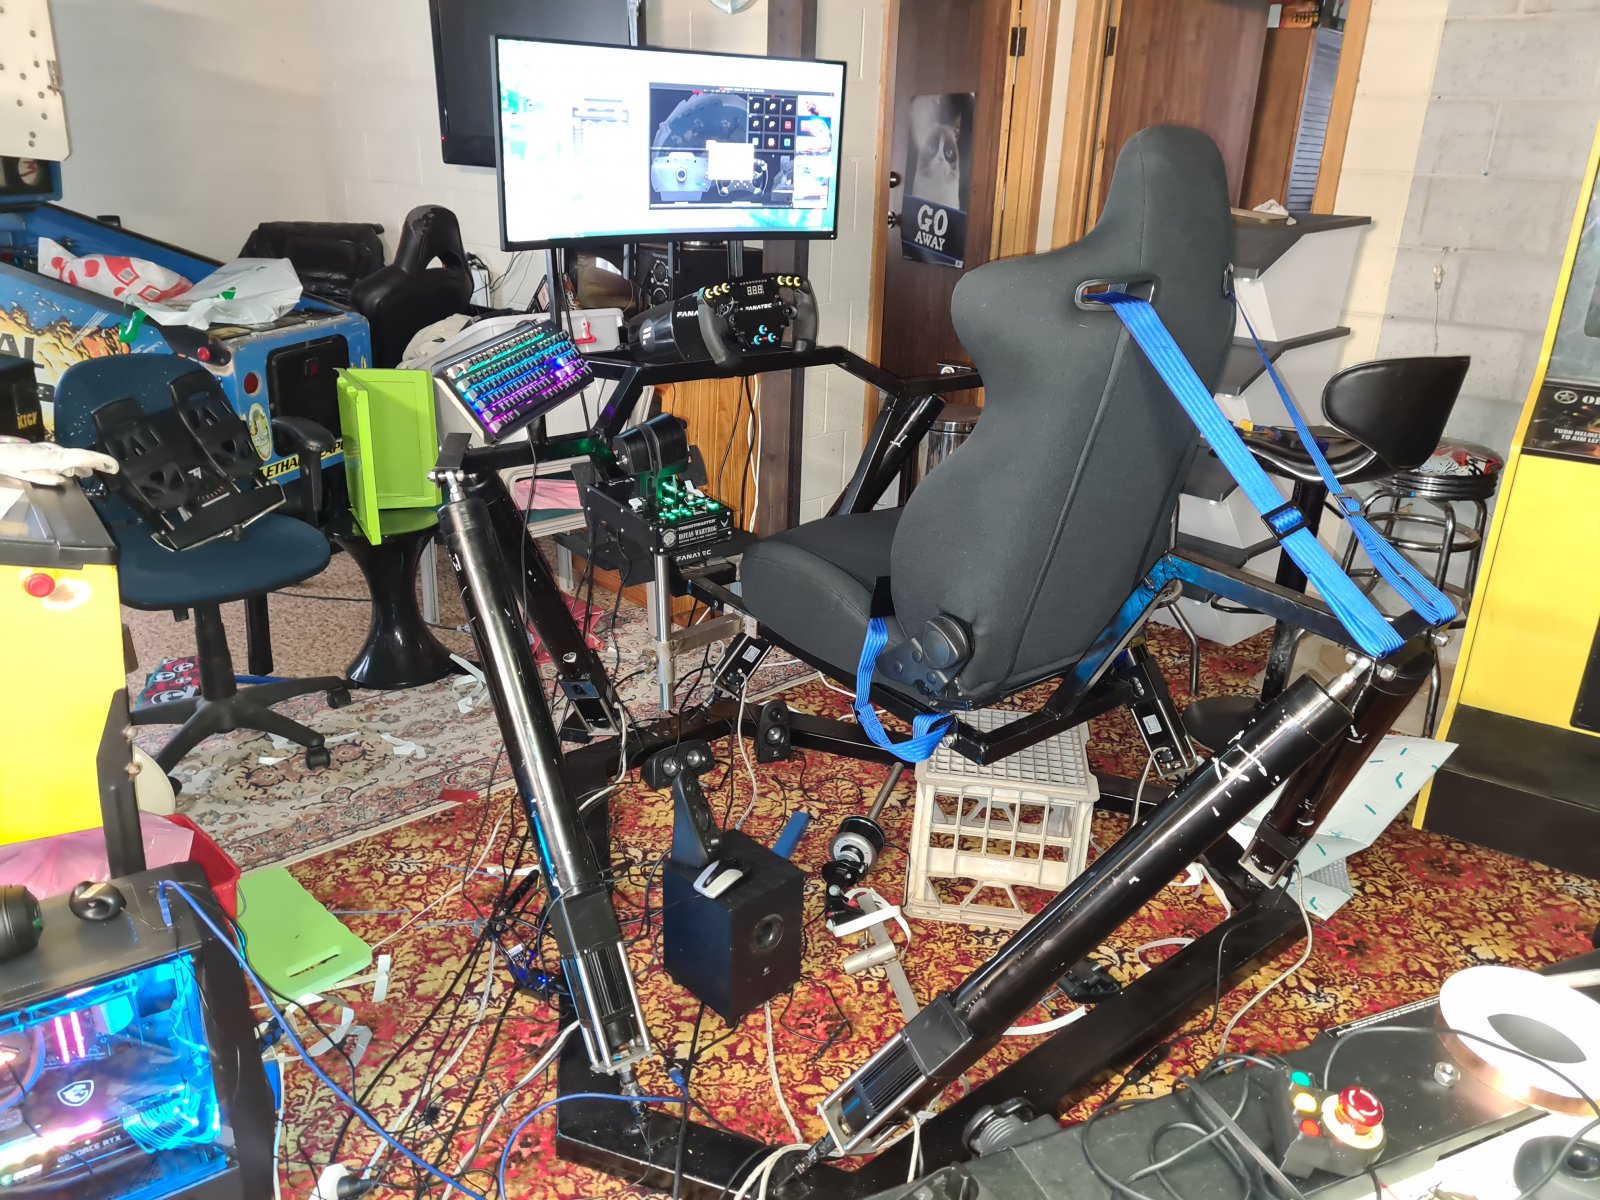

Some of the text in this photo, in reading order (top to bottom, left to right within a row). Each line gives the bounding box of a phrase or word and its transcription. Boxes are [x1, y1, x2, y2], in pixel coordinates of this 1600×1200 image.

[918, 204, 948, 236] GO
[914, 231, 945, 251] AWAY
[745, 302, 772, 311] FANATEC
[676, 549, 712, 561] FANATEC
[102, 1134, 122, 1147] RTX
